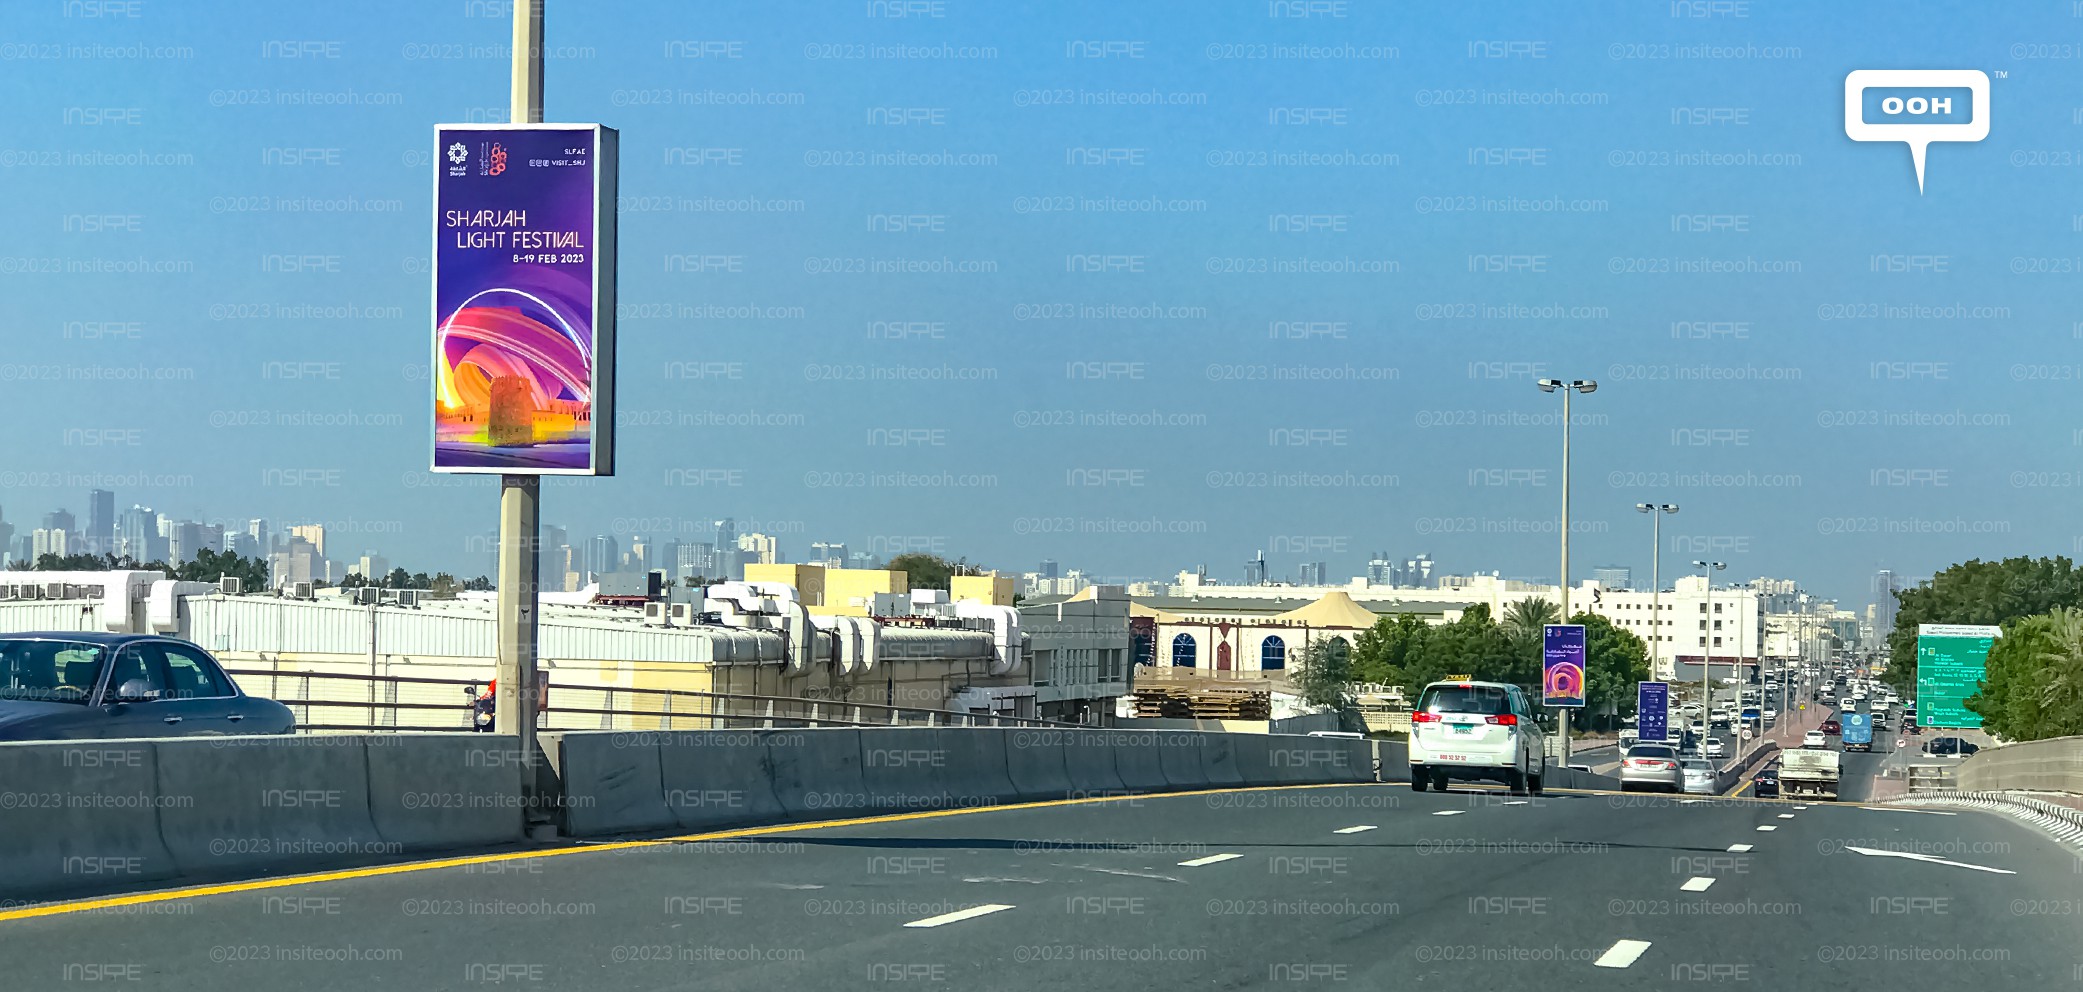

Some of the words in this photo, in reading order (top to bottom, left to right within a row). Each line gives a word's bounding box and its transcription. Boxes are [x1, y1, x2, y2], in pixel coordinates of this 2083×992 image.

[446, 210, 526, 227] SHARJAH
[457, 231, 505, 248] LIGHT
[513, 231, 584, 248] FESTIVAL
[513, 254, 535, 263] 8-19
[538, 254, 557, 263] FEB
[560, 254, 584, 263] 2023
